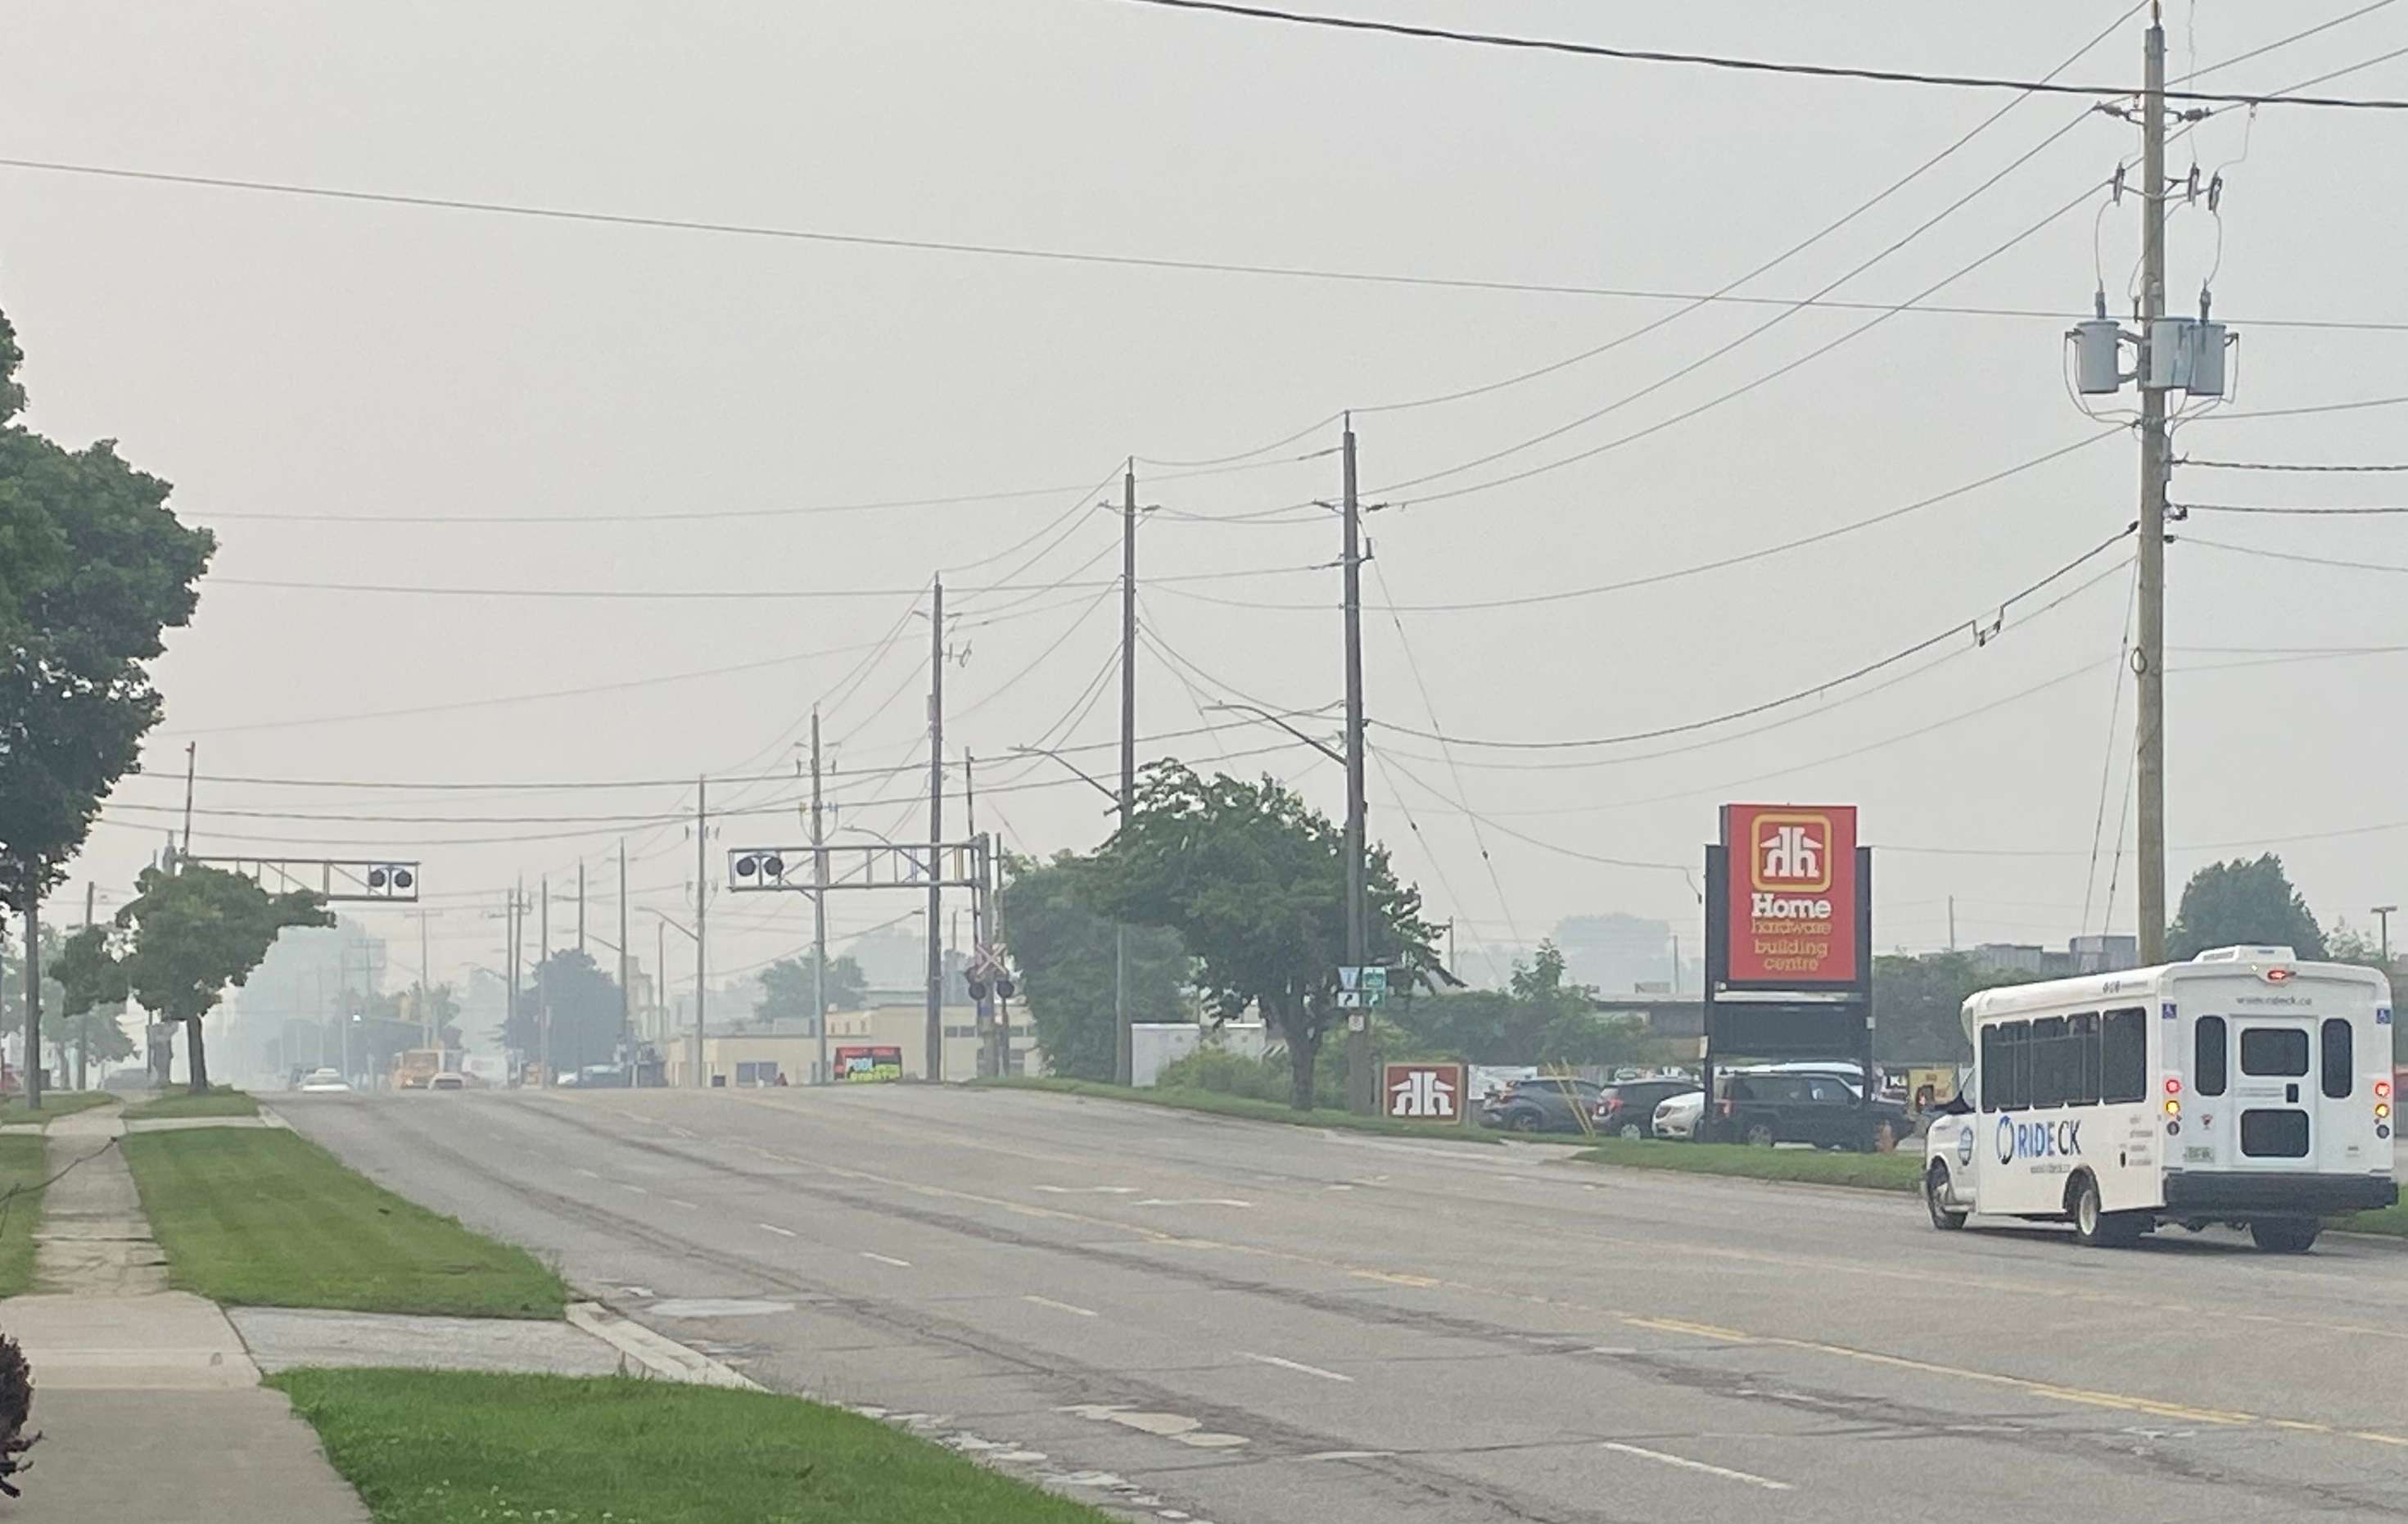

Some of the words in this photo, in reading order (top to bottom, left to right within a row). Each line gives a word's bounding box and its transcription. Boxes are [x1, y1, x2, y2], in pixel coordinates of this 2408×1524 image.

[1751, 892, 1832, 918] Home
[1751, 918, 1832, 934] hardware
[1755, 938, 1828, 957] building
[1764, 956, 1819, 971] centre
